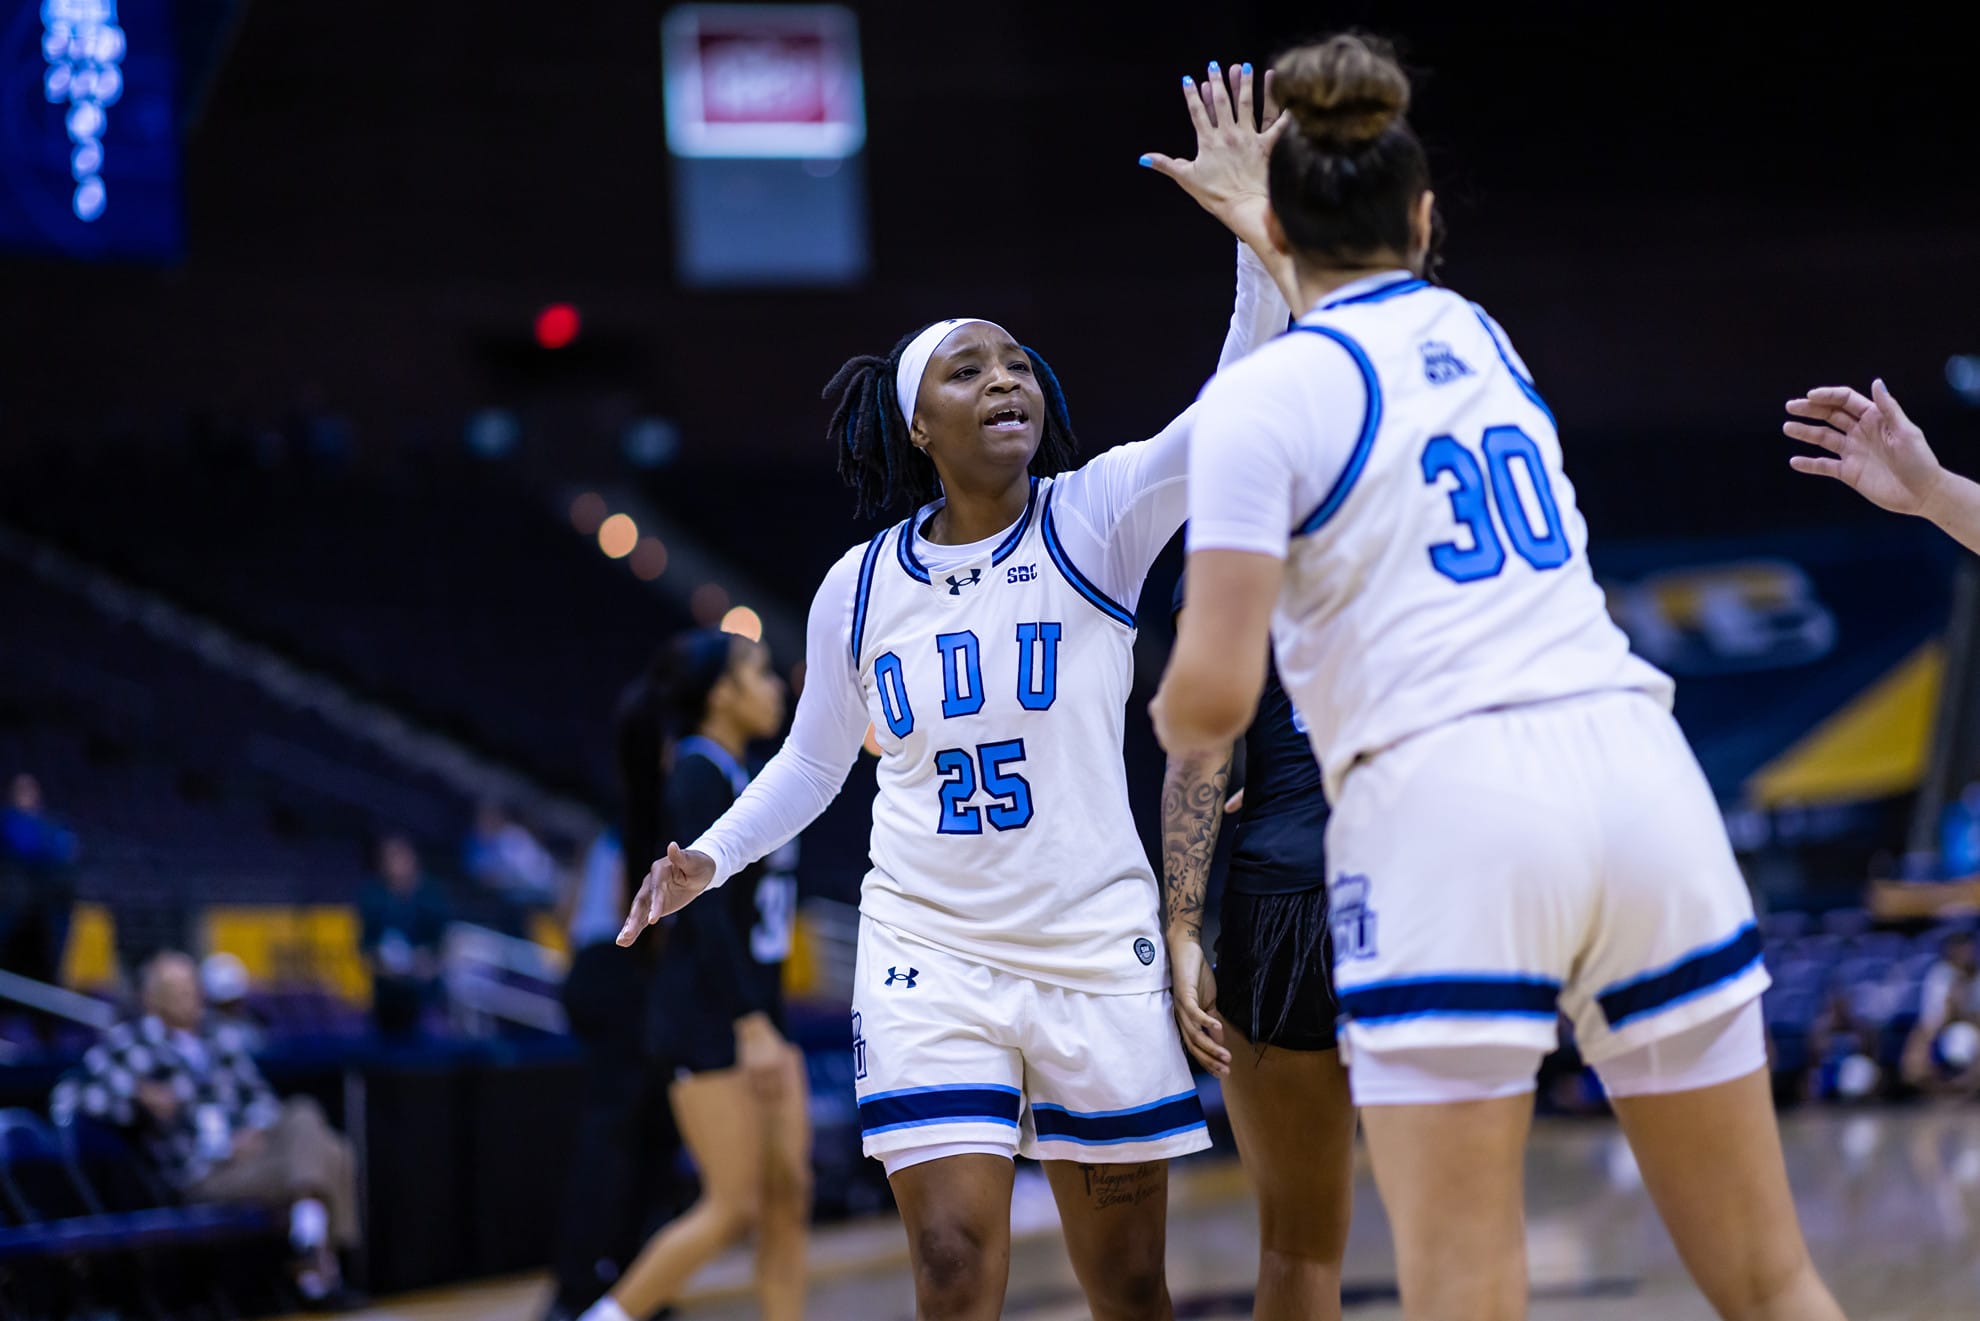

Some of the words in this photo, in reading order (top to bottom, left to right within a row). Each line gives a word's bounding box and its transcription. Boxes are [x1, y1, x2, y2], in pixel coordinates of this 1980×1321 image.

[1420, 424, 1572, 584] 30
[1007, 563, 1038, 584] SBC
[874, 621, 1062, 739] ODU
[934, 737, 1034, 834] 25
